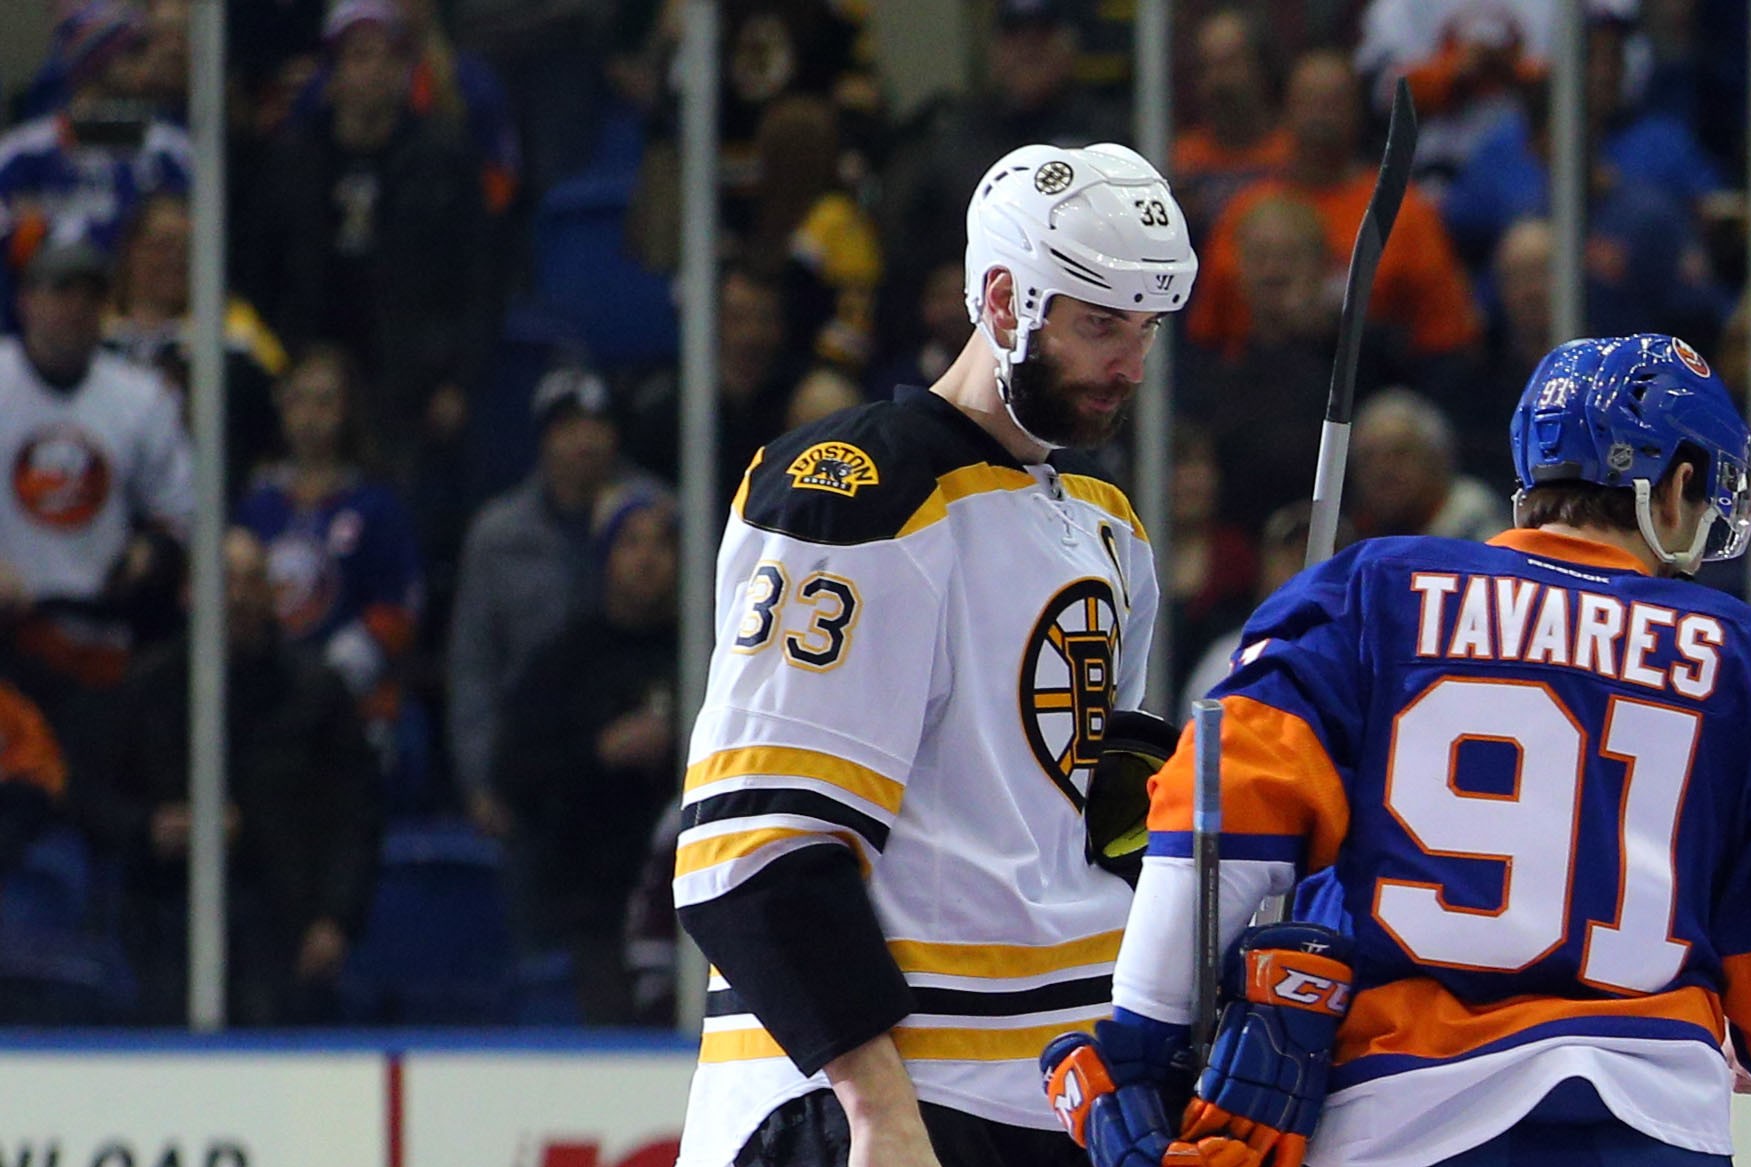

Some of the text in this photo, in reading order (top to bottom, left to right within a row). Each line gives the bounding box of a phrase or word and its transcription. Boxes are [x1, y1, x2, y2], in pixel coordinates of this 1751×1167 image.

[1134, 200, 1169, 227] 33
[1538, 377, 1570, 408] 91
[794, 445, 874, 481] BOSTON
[731, 560, 863, 674] 33
[1411, 572, 1725, 700] TAVARES
[1371, 675, 1704, 997] 91
